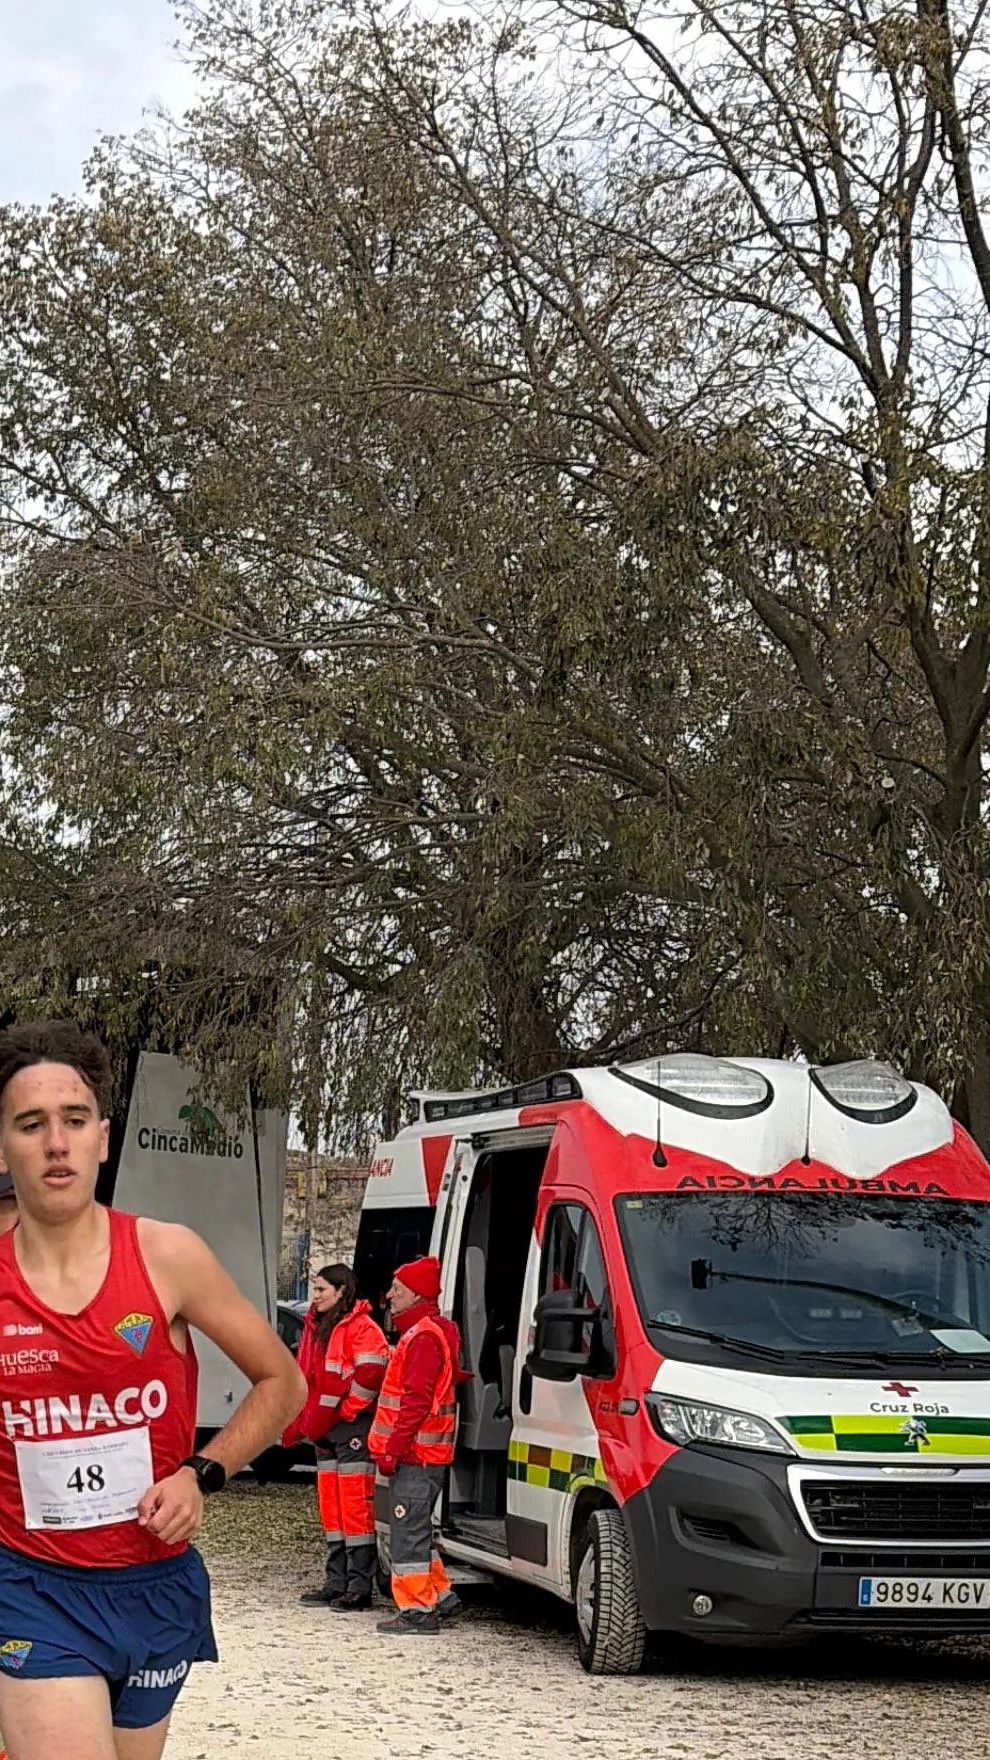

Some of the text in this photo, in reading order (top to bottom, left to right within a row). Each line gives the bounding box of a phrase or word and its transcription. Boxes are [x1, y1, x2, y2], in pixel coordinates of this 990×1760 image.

[1, 1379, 168, 1438] HINACO
[870, 1403, 950, 1416] Cruz Roja
[66, 1464, 105, 1493] 48
[876, 1582, 985, 1604] 9894 KGV
